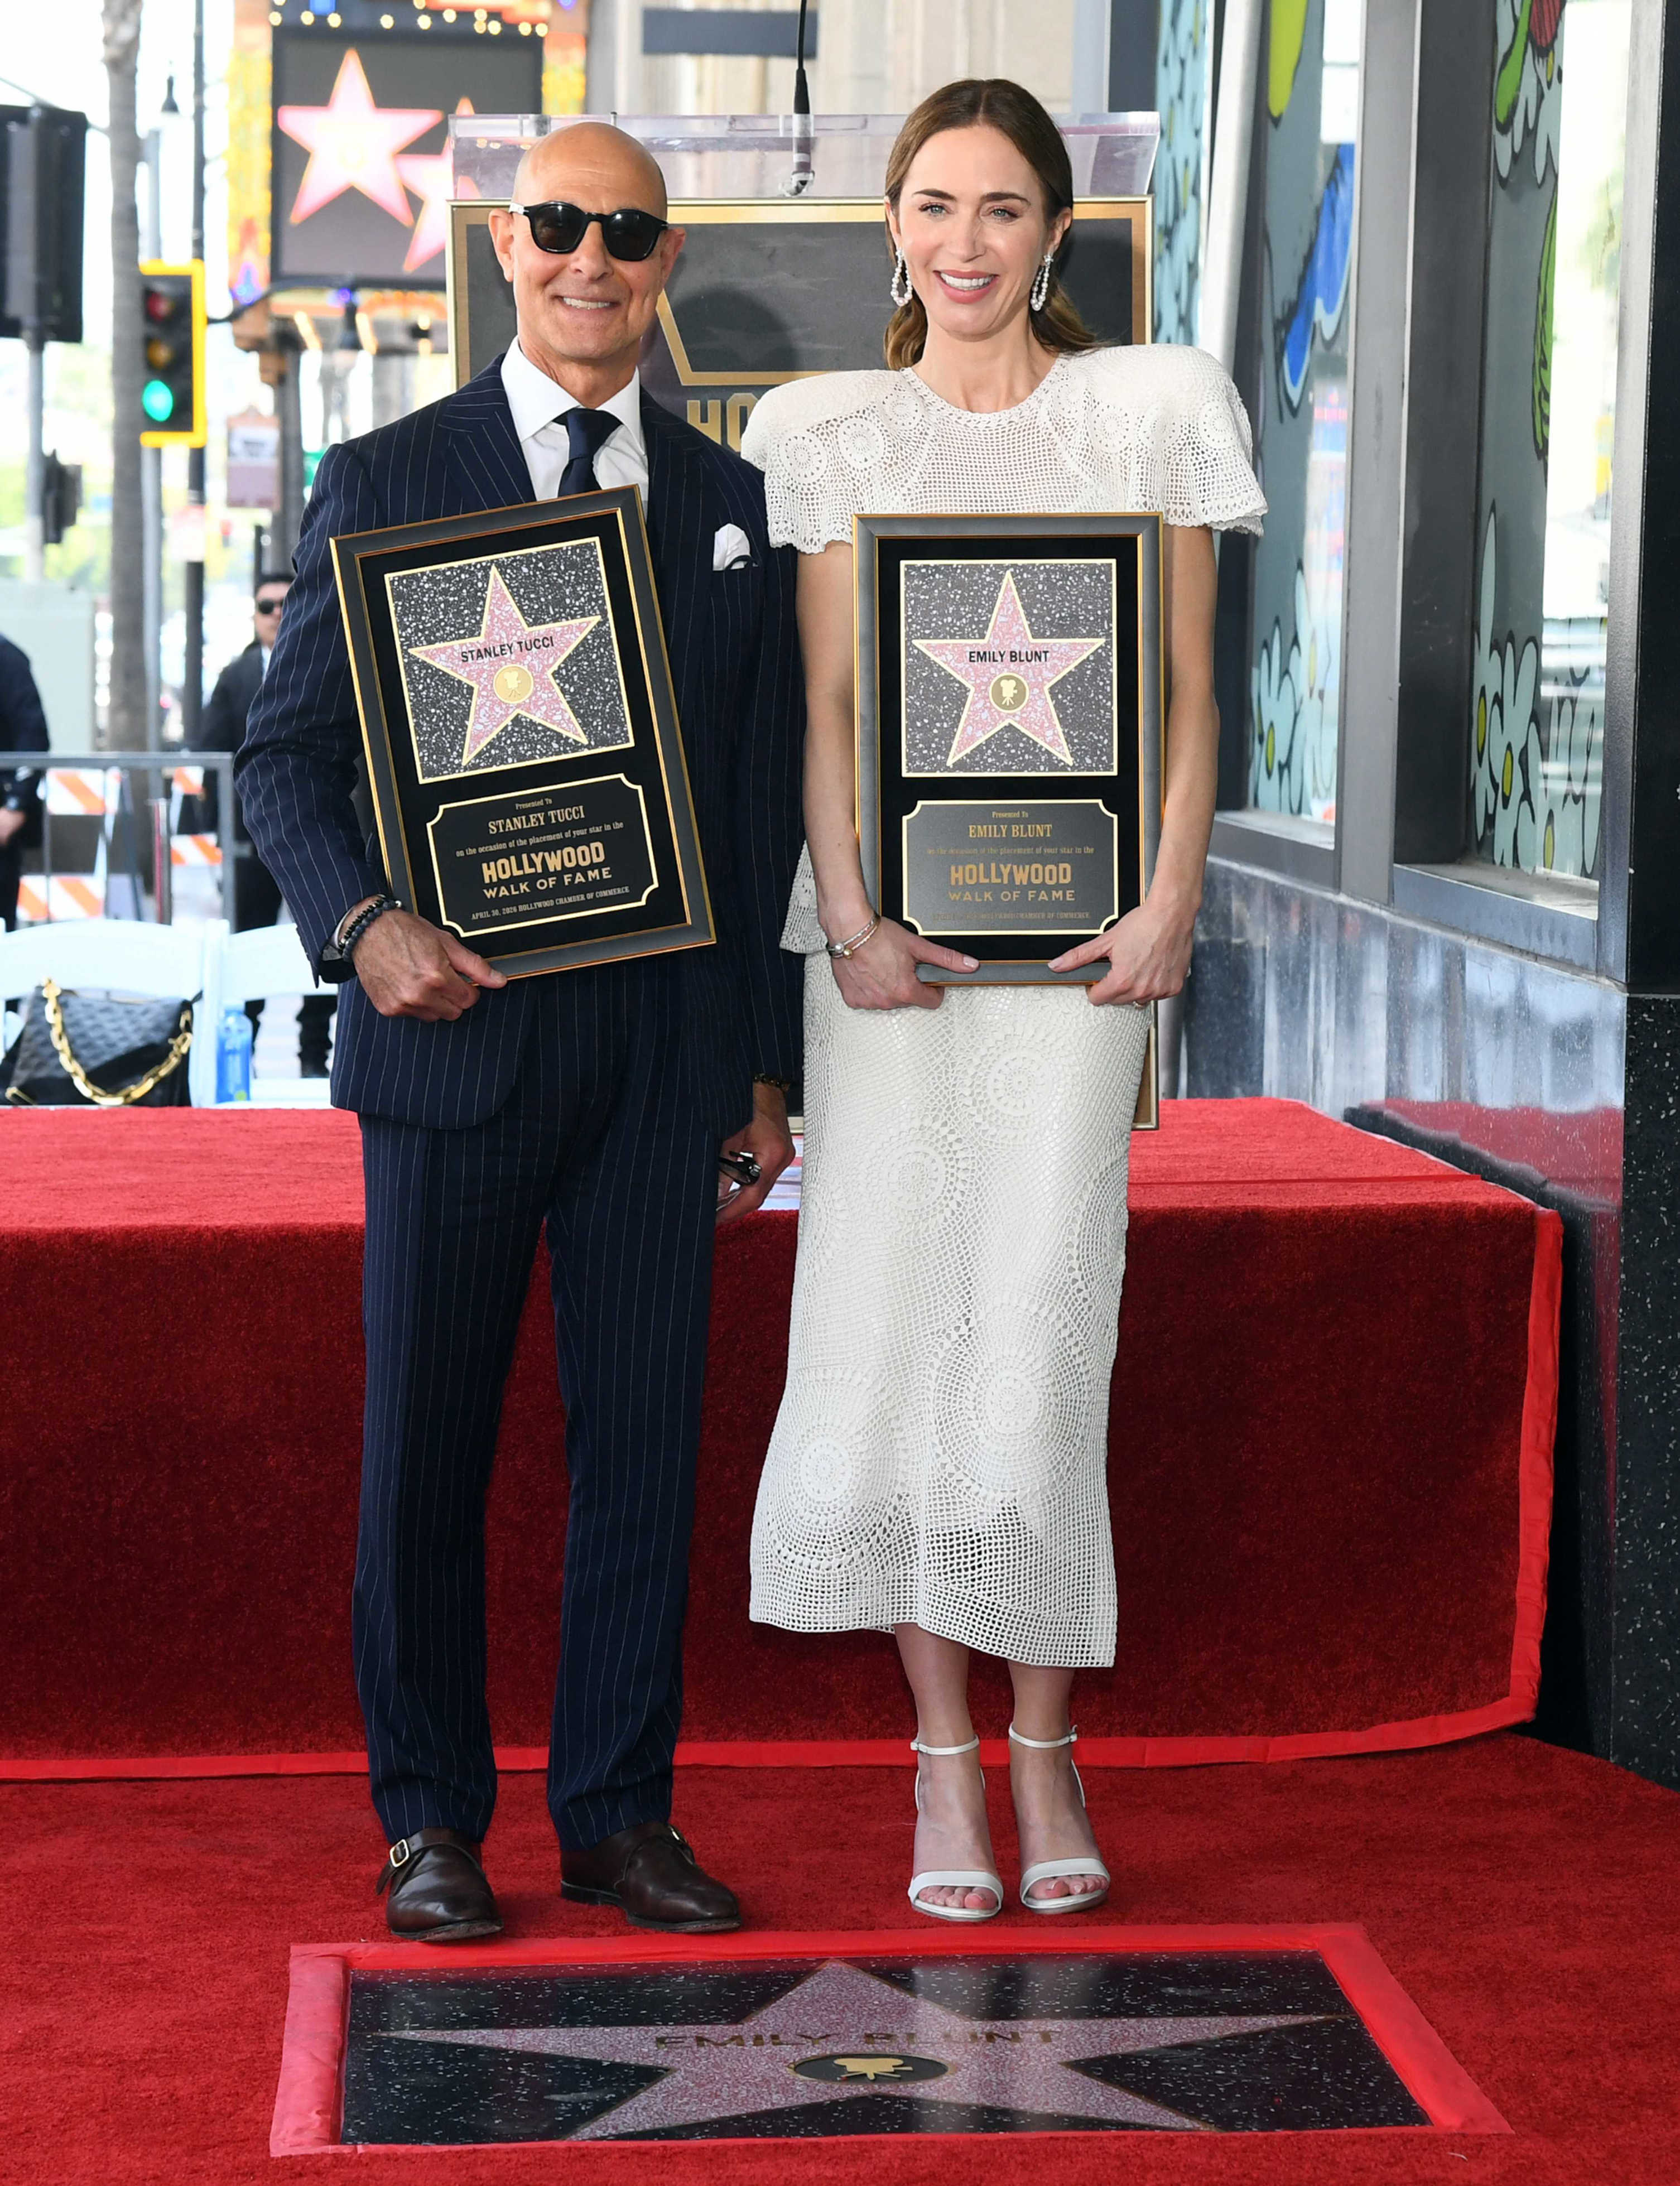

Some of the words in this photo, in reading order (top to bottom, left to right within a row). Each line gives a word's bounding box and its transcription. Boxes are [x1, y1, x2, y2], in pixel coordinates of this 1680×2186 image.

[461, 642, 513, 662] STANLEY
[517, 636, 554, 652] TUCCI
[969, 651, 1005, 662] EMILY
[1010, 651, 1049, 662] BLUNT
[516, 799, 544, 810] Presented
[488, 812, 545, 834] STANLEY
[548, 805, 585, 824] TUCCI
[969, 825, 1007, 837] EMILY
[1012, 824, 1052, 837] BLUNT
[466, 847, 477, 856] the
[478, 841, 507, 853] occasion
[517, 837, 527, 846] the
[528, 832, 563, 845] placement
[573, 828, 587, 839] your
[589, 825, 602, 834] star
[613, 821, 624, 830] the
[1000, 846, 1033, 856] placement
[1036, 846, 1043, 854] of
[1043, 847, 1058, 856] your
[1084, 846, 1095, 854] the
[482, 841, 605, 884] HOLLYWOOD
[482, 882, 531, 899] WALK
[536, 877, 557, 890] OF
[563, 867, 612, 886] FAME
[950, 863, 1072, 885] HOLLYWOOD
[471, 908, 490, 920] APRIL
[502, 906, 517, 915] 2026
[518, 899, 555, 912] HOLLYWOOD
[555, 894, 585, 906] CHAMBER
[586, 892, 594, 900] OF
[595, 886, 630, 898] COMMERCE
[949, 890, 993, 902] WALK
[1000, 890, 1021, 902] OF
[1028, 890, 1076, 901] FAME
[656, 2034, 841, 2049] EMILY
[865, 2031, 1061, 2045] BLUNT
